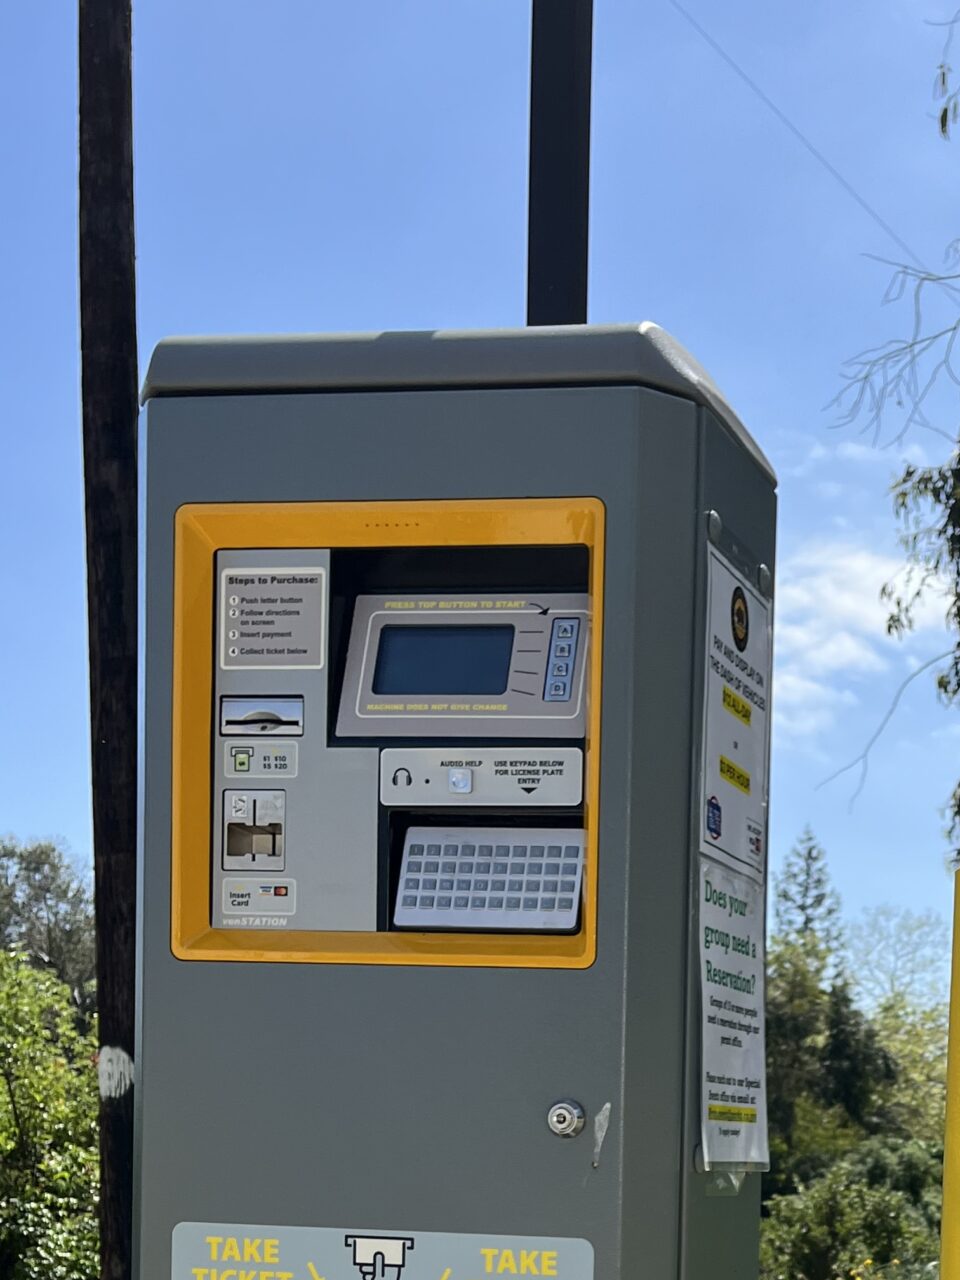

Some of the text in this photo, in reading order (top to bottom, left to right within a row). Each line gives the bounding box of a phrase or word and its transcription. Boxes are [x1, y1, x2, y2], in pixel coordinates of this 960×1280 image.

[228, 577, 255, 586] Steps
[270, 576, 318, 584] Purchase:
[384, 601, 415, 609] PRESS
[418, 601, 436, 609] TOP
[438, 601, 478, 609] BUTTON
[496, 600, 527, 608] START
[262, 631, 292, 639] payment
[231, 899, 249, 907] Card
[705, 879, 747, 917] Does your
[704, 926, 756, 958] group need a
[705, 959, 756, 995] Reservation?
[206, 1236, 280, 1264] TAKE
[480, 1248, 558, 1276] TAKE
